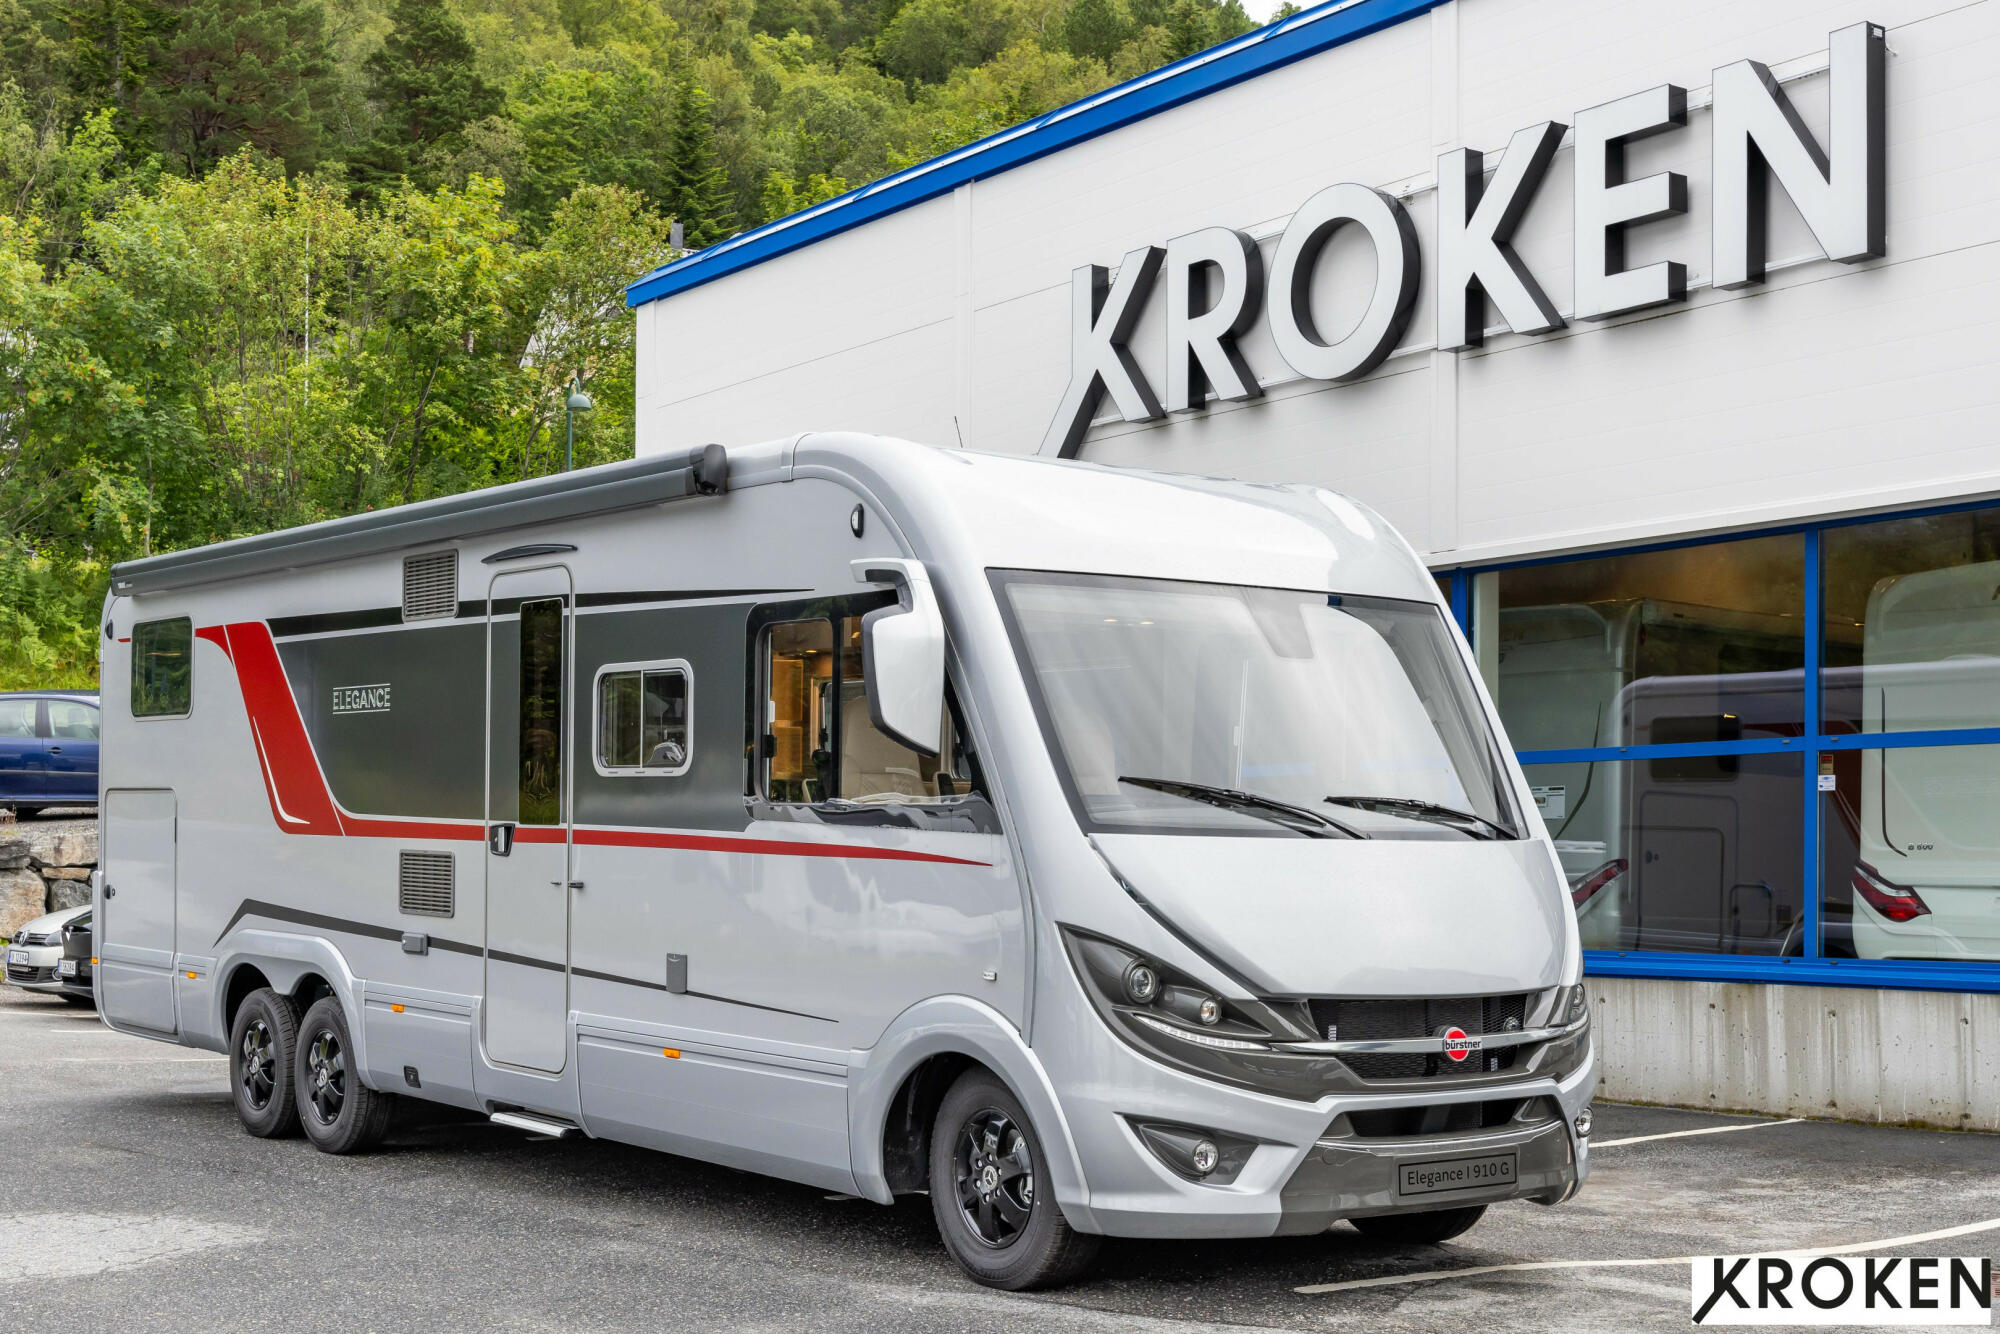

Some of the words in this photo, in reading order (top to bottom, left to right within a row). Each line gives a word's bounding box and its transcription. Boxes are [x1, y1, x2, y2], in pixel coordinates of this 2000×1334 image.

[1037, 20, 1887, 460] KROKEN
[332, 687, 391, 710] ELEGANCE
[1445, 1039, 1482, 1051] bürstner
[1407, 1169, 1464, 1188] Elegance
[1472, 1162, 1498, 1179] 910
[1499, 1161, 1510, 1176] G
